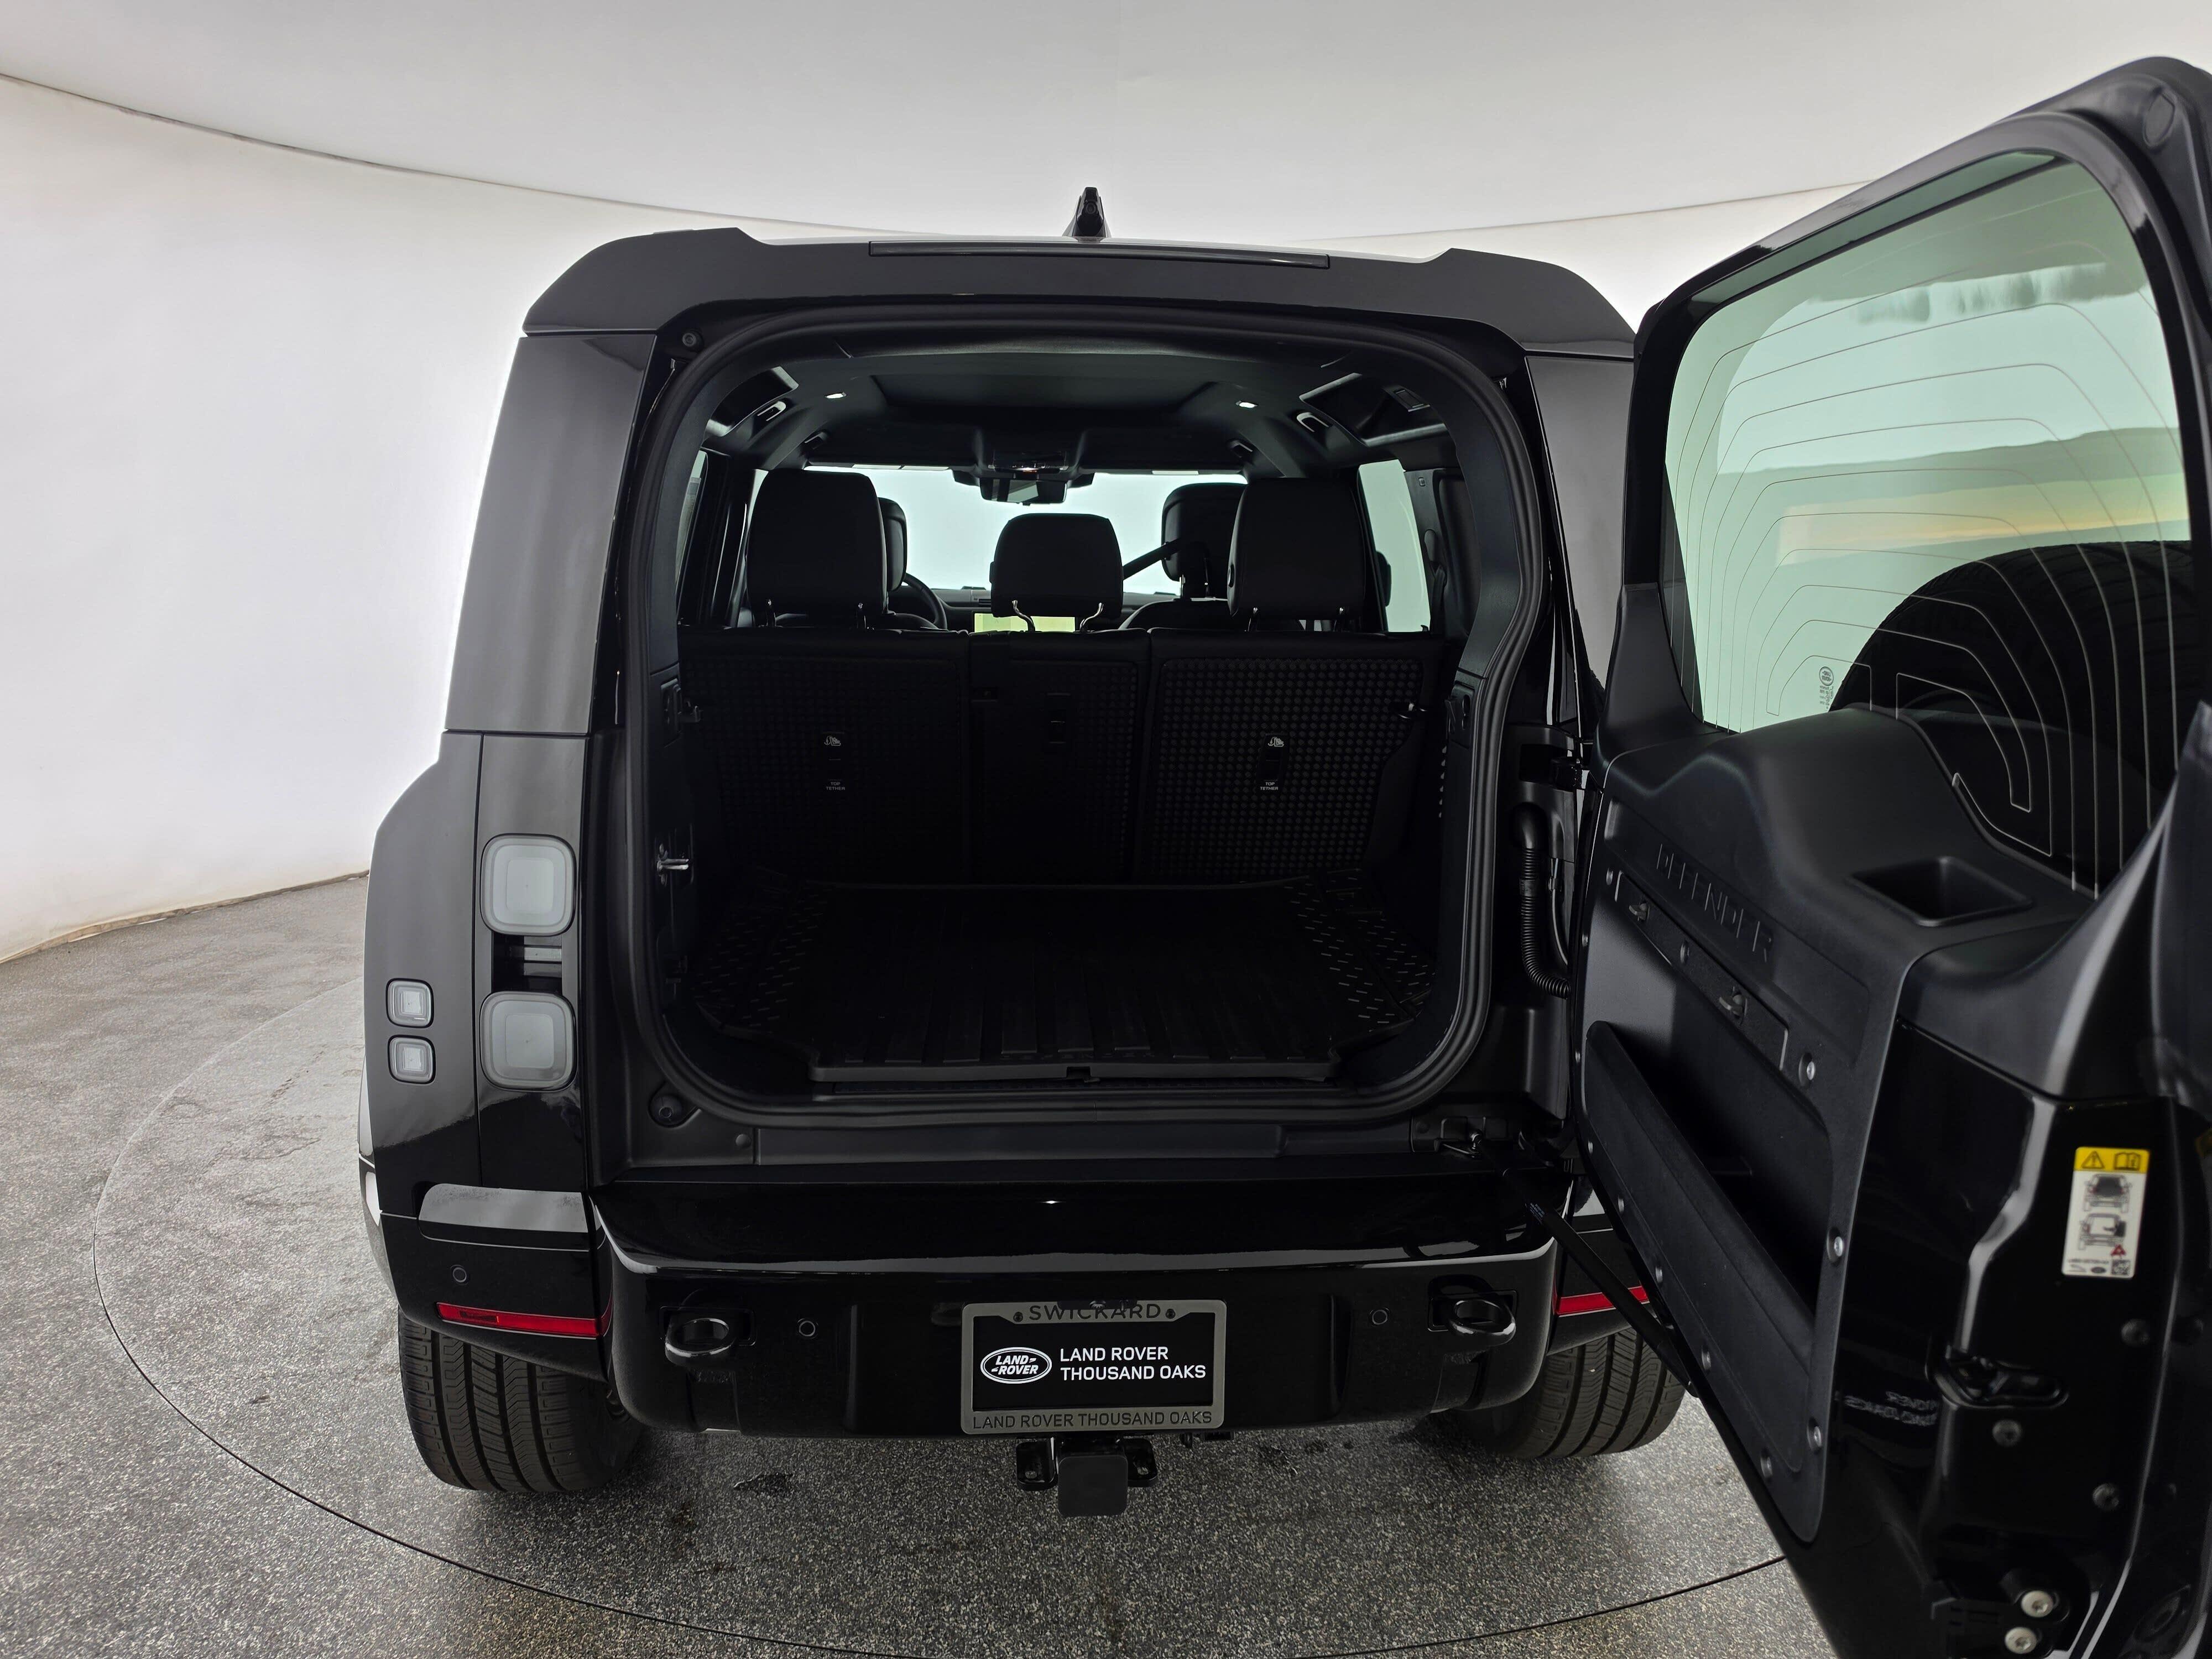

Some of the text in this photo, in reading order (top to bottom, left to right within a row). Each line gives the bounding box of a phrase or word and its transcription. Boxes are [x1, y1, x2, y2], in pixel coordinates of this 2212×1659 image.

[1656, 841, 1773, 963] DEFENDER
[1029, 1303, 1161, 1321] SWICKARD
[995, 1355, 1029, 1365] LAND
[1060, 1347, 1168, 1362] LAND ROVER
[998, 1364, 1039, 1375] ROVER
[1060, 1365, 1206, 1381] THOUSAND OAKS
[973, 1411, 1212, 1429] LAND ROVER THOUSAND OAKS
